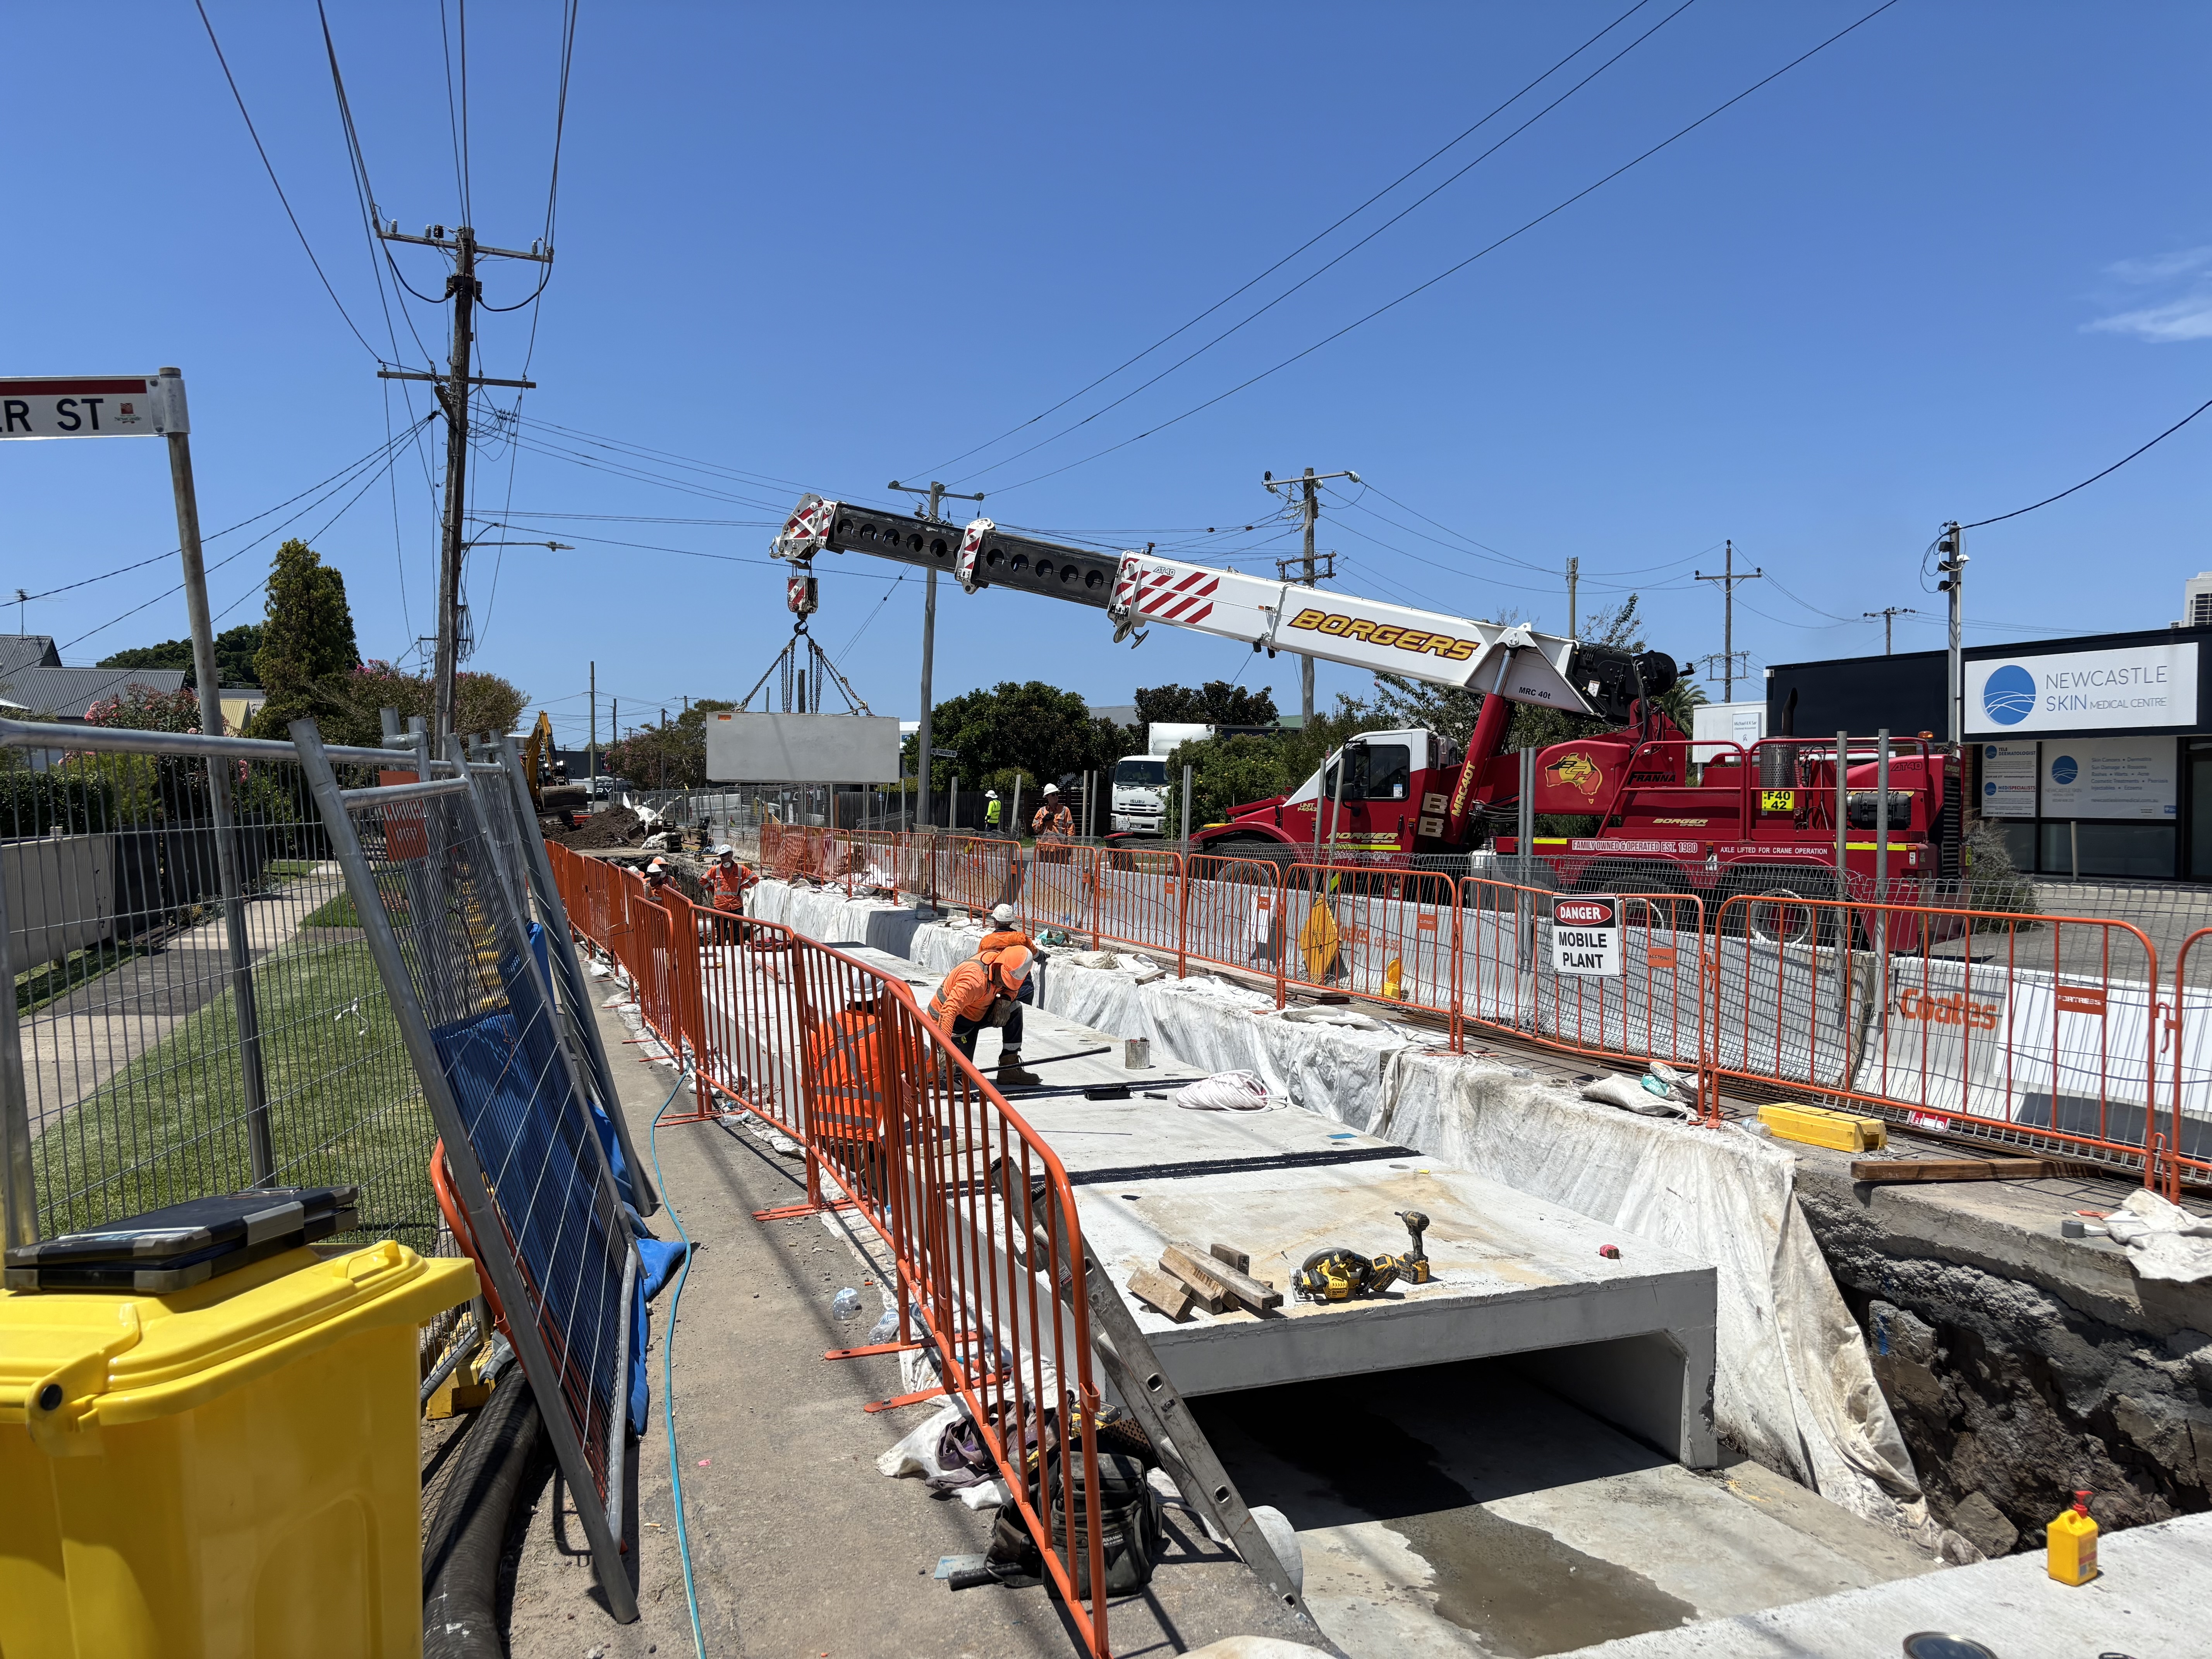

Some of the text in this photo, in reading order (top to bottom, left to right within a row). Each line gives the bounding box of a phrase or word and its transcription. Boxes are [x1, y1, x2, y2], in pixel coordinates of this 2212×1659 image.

[0, 398, 104, 432] R ST
[1287, 608, 1481, 661] BORGERS
[2046, 665, 2168, 689] NEWCASTLE
[1518, 687, 1551, 699] MRC 40t
[2046, 694, 2167, 711] SKIN MEDICAL CENTRE
[1626, 771, 1676, 785] FRANNA
[1451, 760, 1475, 817] MRC40T
[1767, 791, 1791, 800] F40
[1771, 800, 1787, 809] 42
[1573, 841, 1697, 853] FAMILY OWNED & OPERATED EST. 1980
[1560, 906, 1601, 920] DANGER
[1559, 931, 1607, 948] MOBILE
[1563, 952, 1603, 969] PLANT
[2057, 994, 2101, 1005] FORTRESS
[1900, 988, 1997, 1030] Coates
